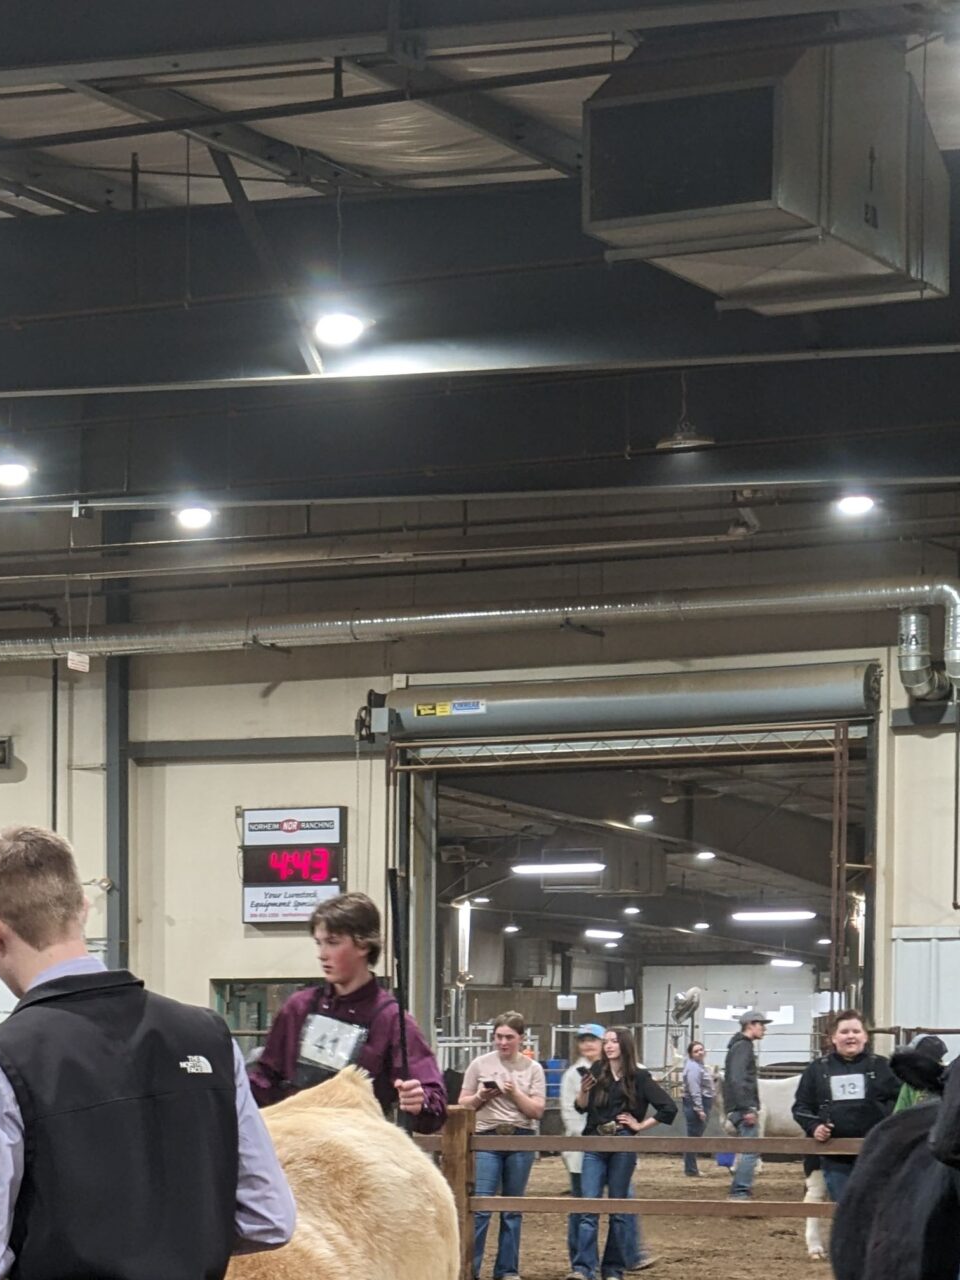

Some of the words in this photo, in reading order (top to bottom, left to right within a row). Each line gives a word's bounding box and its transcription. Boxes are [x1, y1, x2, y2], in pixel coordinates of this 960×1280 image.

[249, 823, 279, 831] NORHEIM
[282, 821, 298, 831] NOR
[301, 820, 334, 829] RANCHING
[269, 847, 329, 882] 4:43
[840, 1082, 857, 1095] 13
